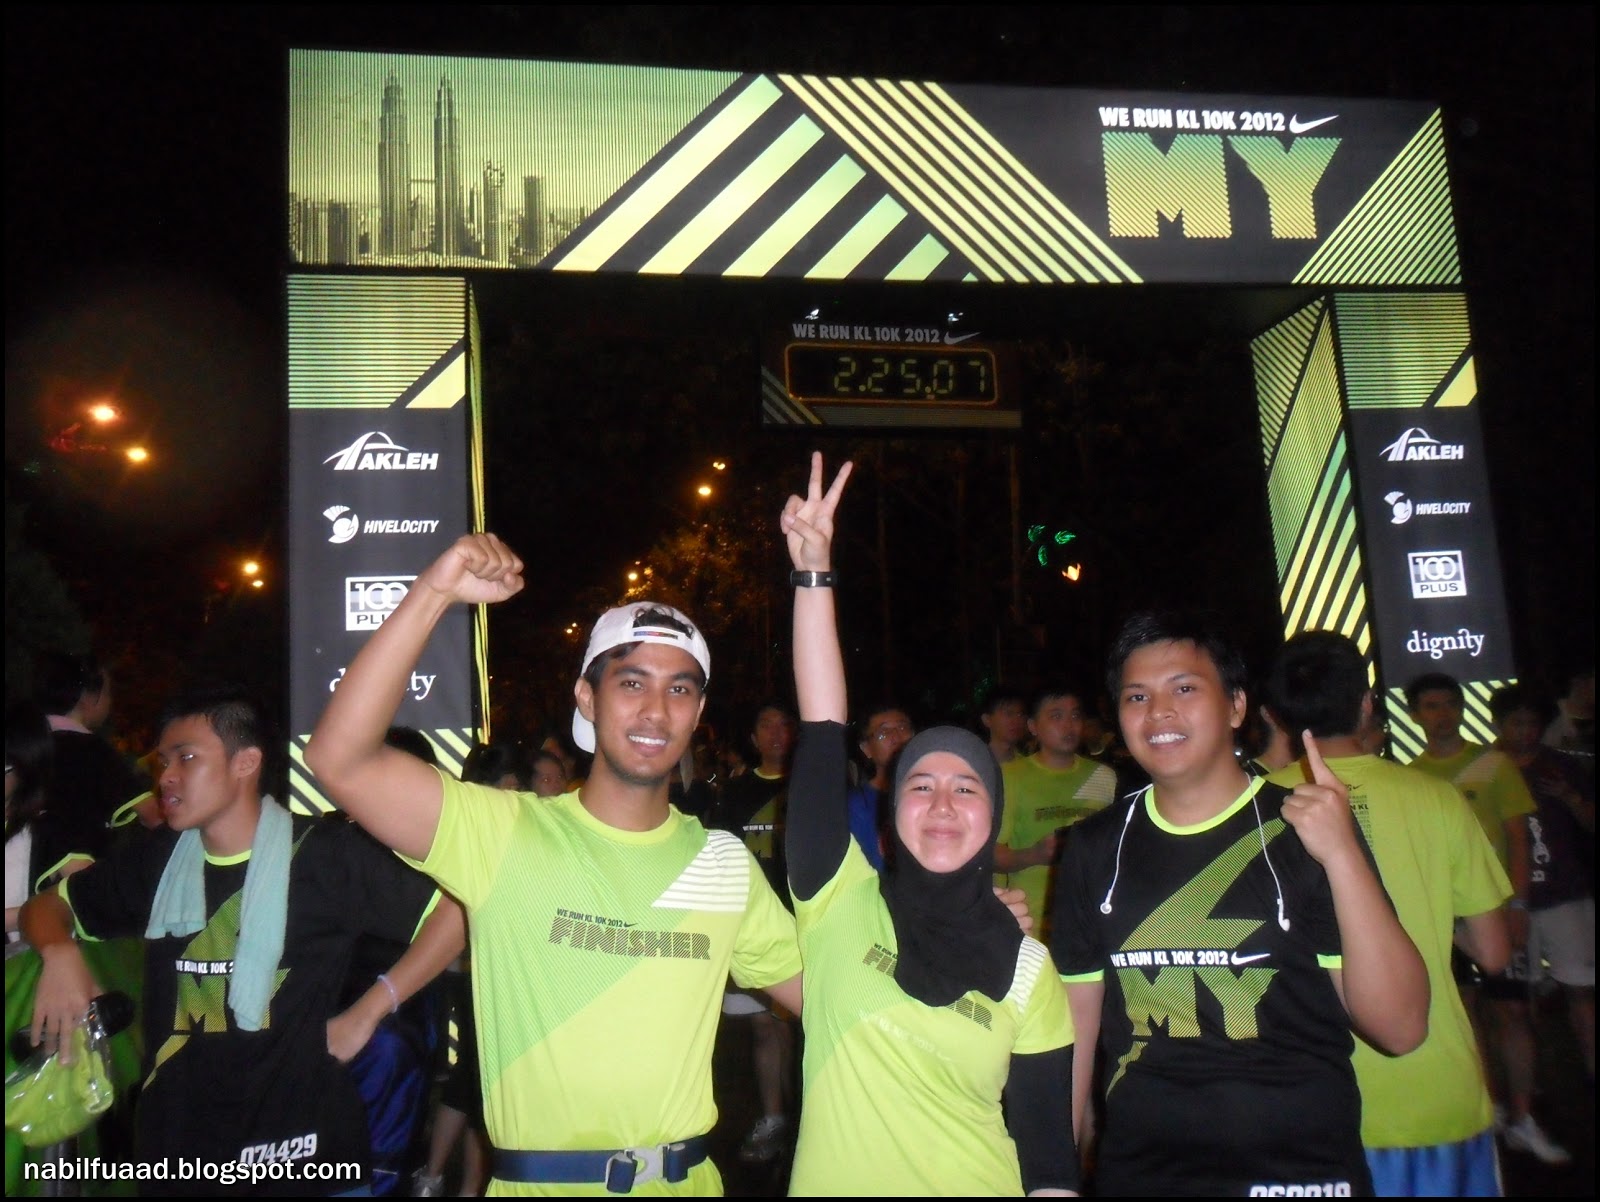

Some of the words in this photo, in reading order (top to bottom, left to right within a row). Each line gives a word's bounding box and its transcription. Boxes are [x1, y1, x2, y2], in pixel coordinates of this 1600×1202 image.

[1098, 107, 1129, 127] WE
[1133, 108, 1172, 129] RUN
[1176, 109, 1200, 130] KL
[1202, 110, 1236, 130] 10K
[1240, 112, 1285, 132] 2012
[1101, 131, 1343, 239] MY
[793, 323, 815, 338] WE
[819, 325, 850, 340] RUN
[854, 326, 871, 341] KL
[874, 327, 900, 342] 10K
[904, 328, 939, 343] 2012
[357, 452, 439, 470] AKLEH
[1405, 445, 1464, 461] AKLEH
[1416, 502, 1471, 515] HIVELOCITY
[363, 520, 439, 533] HIVELOCITY
[1415, 556, 1457, 581] 100
[1420, 582, 1458, 593] PLUS
[1406, 628, 1485, 660] dignity
[557, 908, 568, 917] WE
[569, 911, 584, 920] RUN
[585, 914, 593, 923] KL
[595, 916, 607, 925] 10K
[608, 918, 623, 928] 2012
[548, 916, 711, 960] FINISHER
[198, 962, 208, 973] KL
[210, 962, 227, 974] 10K
[1110, 952, 1127, 967] WE
[1128, 951, 1153, 966] RUN
[1154, 951, 1169, 965] KL
[1171, 951, 1195, 965] 10K
[1197, 951, 1228, 965] 2012
[1116, 966, 1280, 1040] MY
[240, 1133, 317, 1168] 074429
